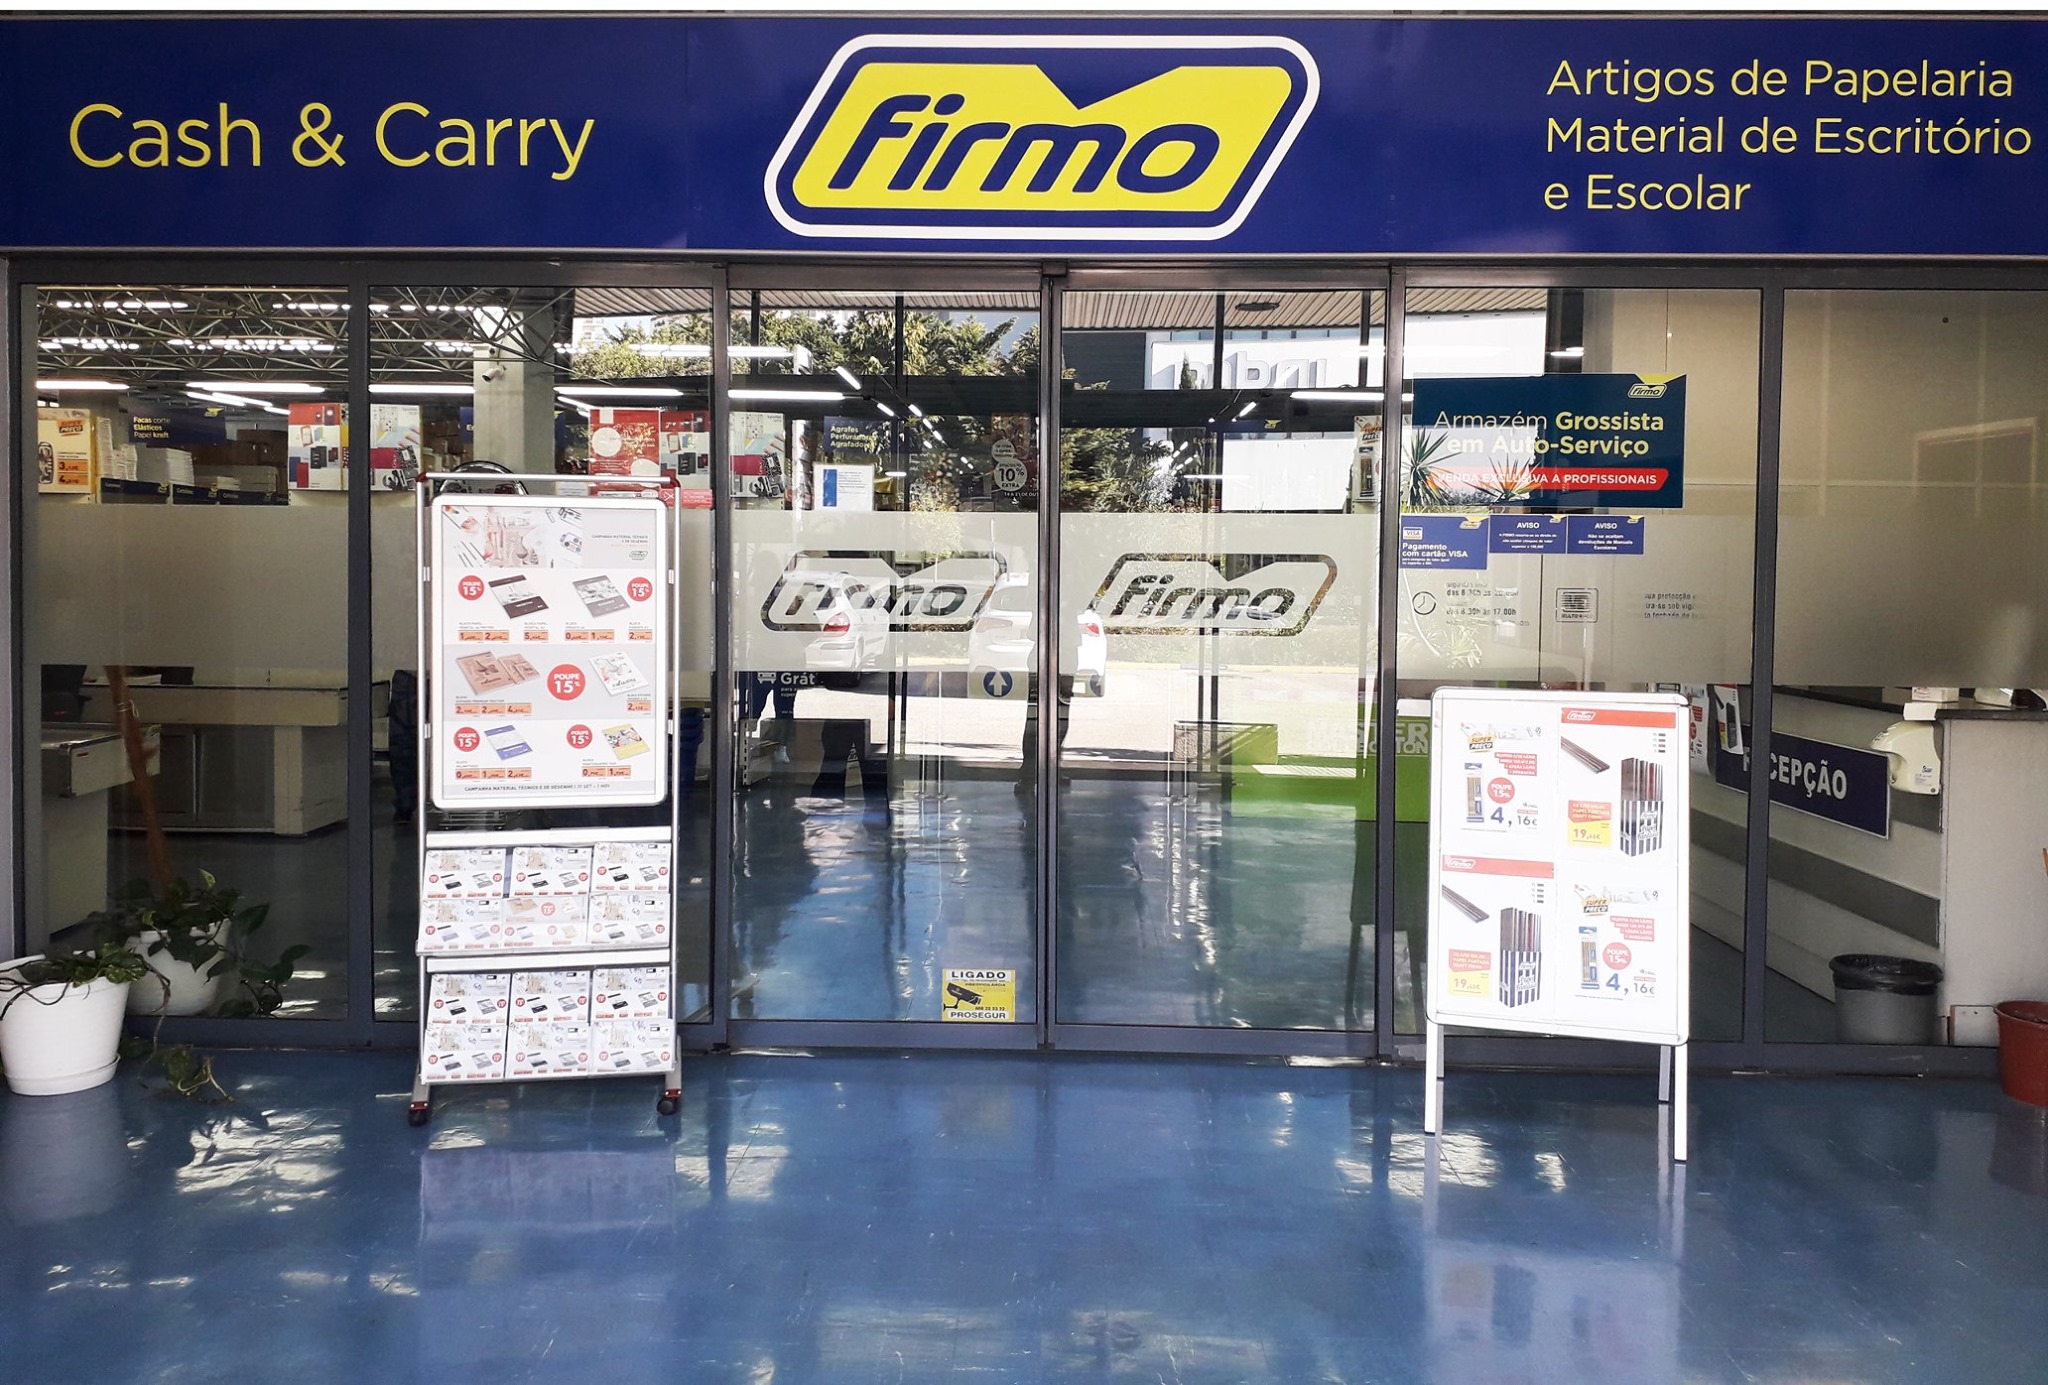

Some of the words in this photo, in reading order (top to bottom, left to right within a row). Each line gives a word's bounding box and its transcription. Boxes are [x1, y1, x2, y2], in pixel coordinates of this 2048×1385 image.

[1546, 59, 1715, 102] Artigos
[1731, 58, 1788, 97] de
[1805, 59, 2013, 103] Papelaria
[69, 102, 261, 169] Cash
[291, 102, 346, 168] &
[375, 101, 595, 181] Carry
[1546, 116, 1723, 154] Material
[1740, 116, 1798, 154] de
[1814, 116, 2032, 155] Escritório
[827, 93, 1220, 194] firmo
[1543, 182, 1569, 210] e
[1586, 174, 1751, 210] Escolar
[1632, 387, 1660, 395] firmo
[133, 416, 152, 424] Facas
[1433, 410, 1548, 430] Armazém
[1555, 411, 1664, 431] Grossista
[133, 423, 162, 431] Elásticos
[830, 425, 859, 434] Agrafes
[133, 431, 152, 440] Papel
[153, 431, 169, 439] kraft
[1447, 438, 1484, 454] em
[1491, 435, 1650, 458] Auto-Serviço
[999, 467, 1025, 482] 10%
[1438, 474, 1479, 484] VENDA
[1481, 474, 1549, 484] EXCLUSIVA
[1564, 474, 1657, 484] PROFISSIONAIS
[1594, 522, 1618, 530] AVISO
[1402, 542, 1448, 551] Pagamento
[1421, 550, 1447, 558] cartão
[1448, 550, 1469, 558] VISA
[1108, 574, 1297, 621] firmo
[1493, 608, 1517, 616] 17.00h
[780, 671, 817, 685] Grát
[554, 680, 581, 694] 15%
[1743, 747, 1847, 800] CEPÇÃO
[951, 971, 1006, 979] LIGADO
[950, 1011, 1006, 1019] PROSEGUR
